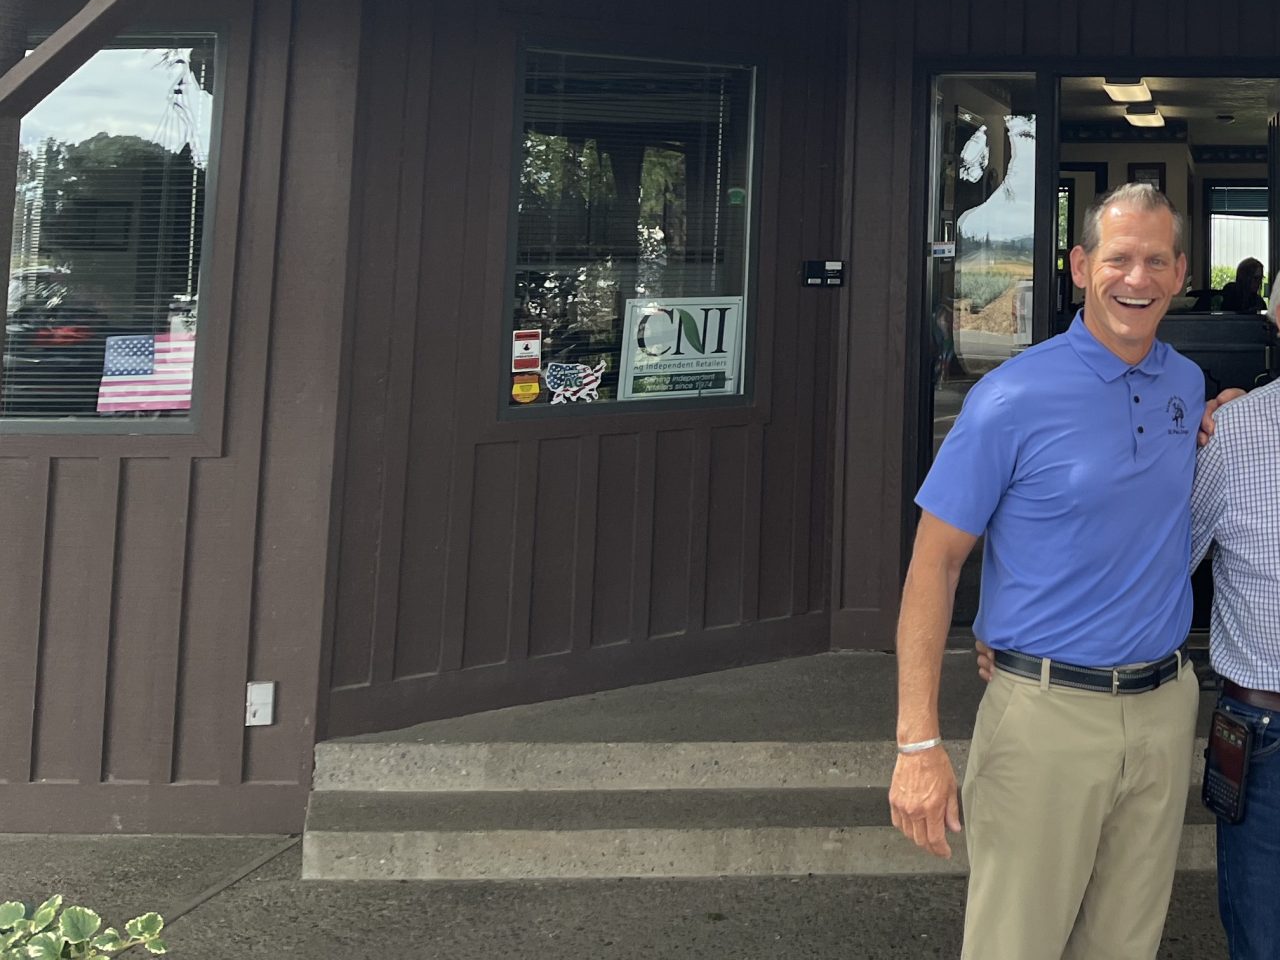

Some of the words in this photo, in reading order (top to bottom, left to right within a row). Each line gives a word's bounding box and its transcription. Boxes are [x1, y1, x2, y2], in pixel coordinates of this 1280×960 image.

[636, 307, 733, 357] CNI
[646, 361, 693, 372] Independent
[695, 359, 727, 369] Retailers
